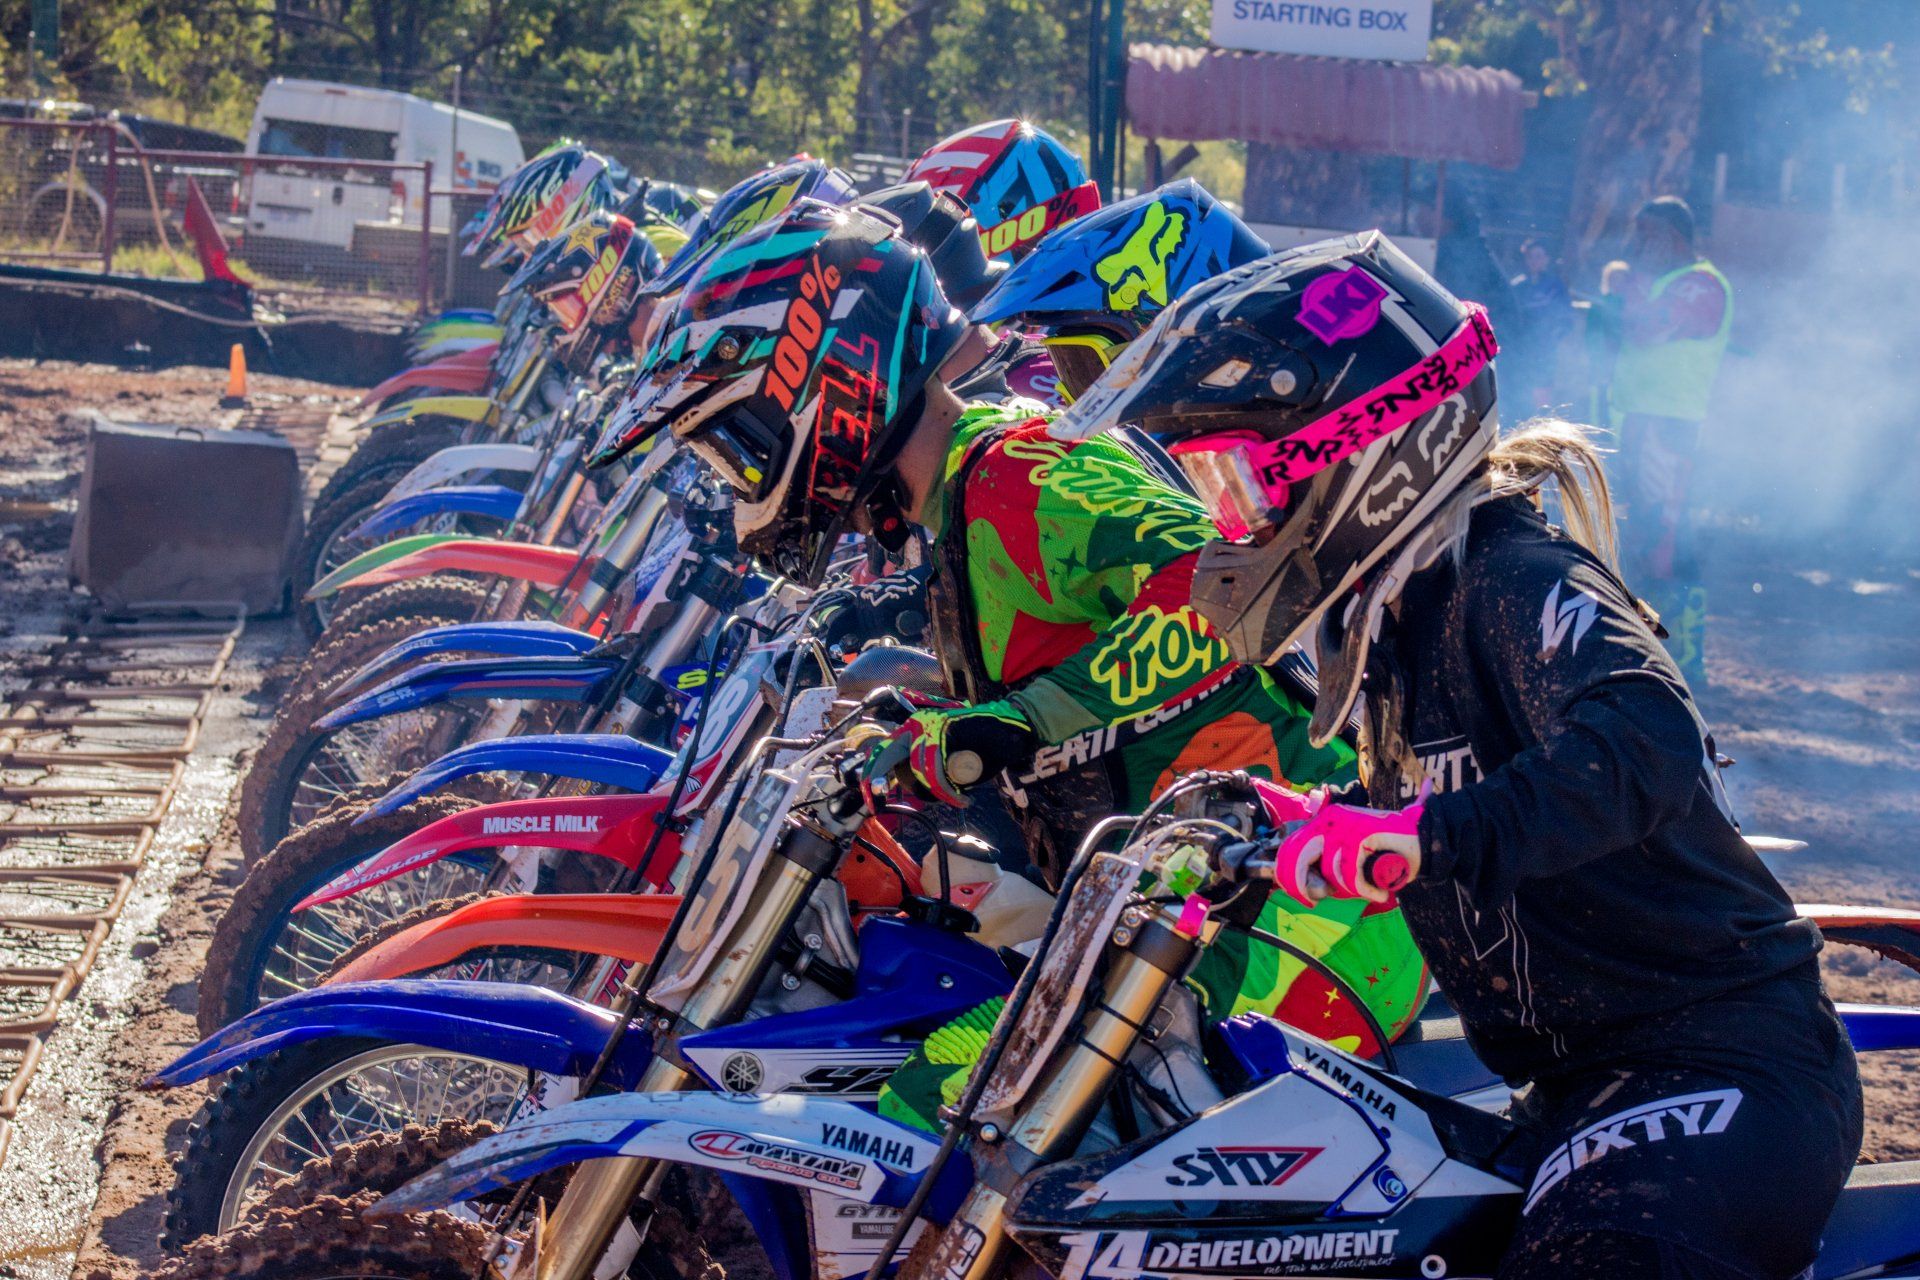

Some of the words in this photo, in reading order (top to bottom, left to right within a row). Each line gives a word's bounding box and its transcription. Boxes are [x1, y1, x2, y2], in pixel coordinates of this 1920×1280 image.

[1233, 0, 1351, 28] STARTING
[1358, 9, 1408, 31] BOX
[764, 253, 842, 412] 100%
[483, 817, 551, 833] MUSCLE
[554, 815, 599, 832] MILK
[343, 848, 438, 890] DUNLOP
[1304, 1046, 1397, 1120] YAMAHA
[821, 1123, 914, 1168] YAMAHA
[750, 1156, 812, 1179] RACING
[816, 1172, 861, 1190] OILS
[1058, 1231, 1149, 1279] 14
[1148, 1229, 1399, 1268] DEVELOPMENT
